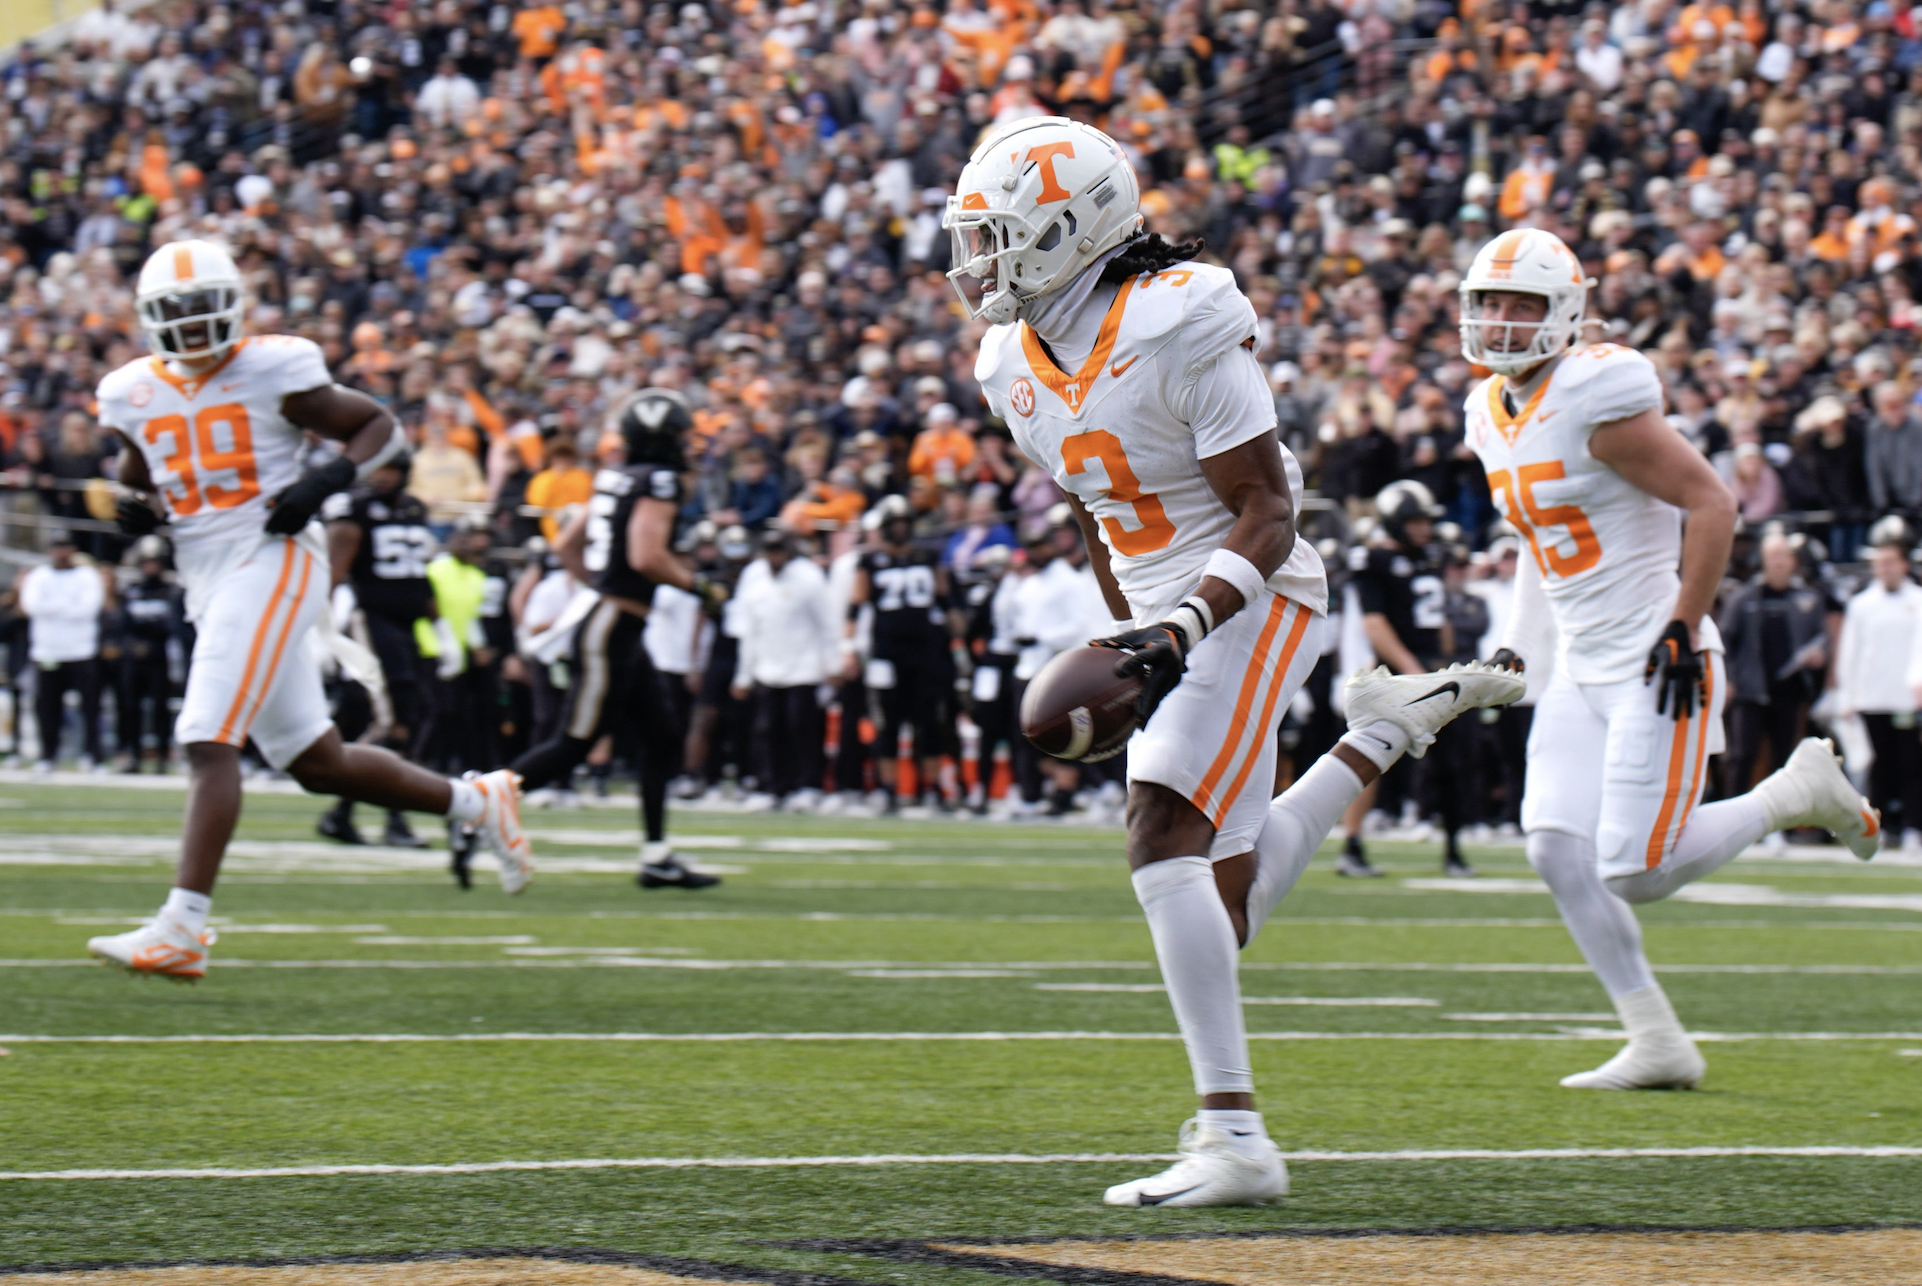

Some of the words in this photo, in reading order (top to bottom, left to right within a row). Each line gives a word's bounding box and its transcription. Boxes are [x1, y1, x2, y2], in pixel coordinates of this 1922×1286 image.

[1010, 141, 1076, 206] T
[1011, 381, 1033, 414] SEC
[1065, 382, 1081, 407] T
[143, 402, 262, 515] 39
[1060, 428, 1177, 557] 3
[873, 564, 936, 611] 70
